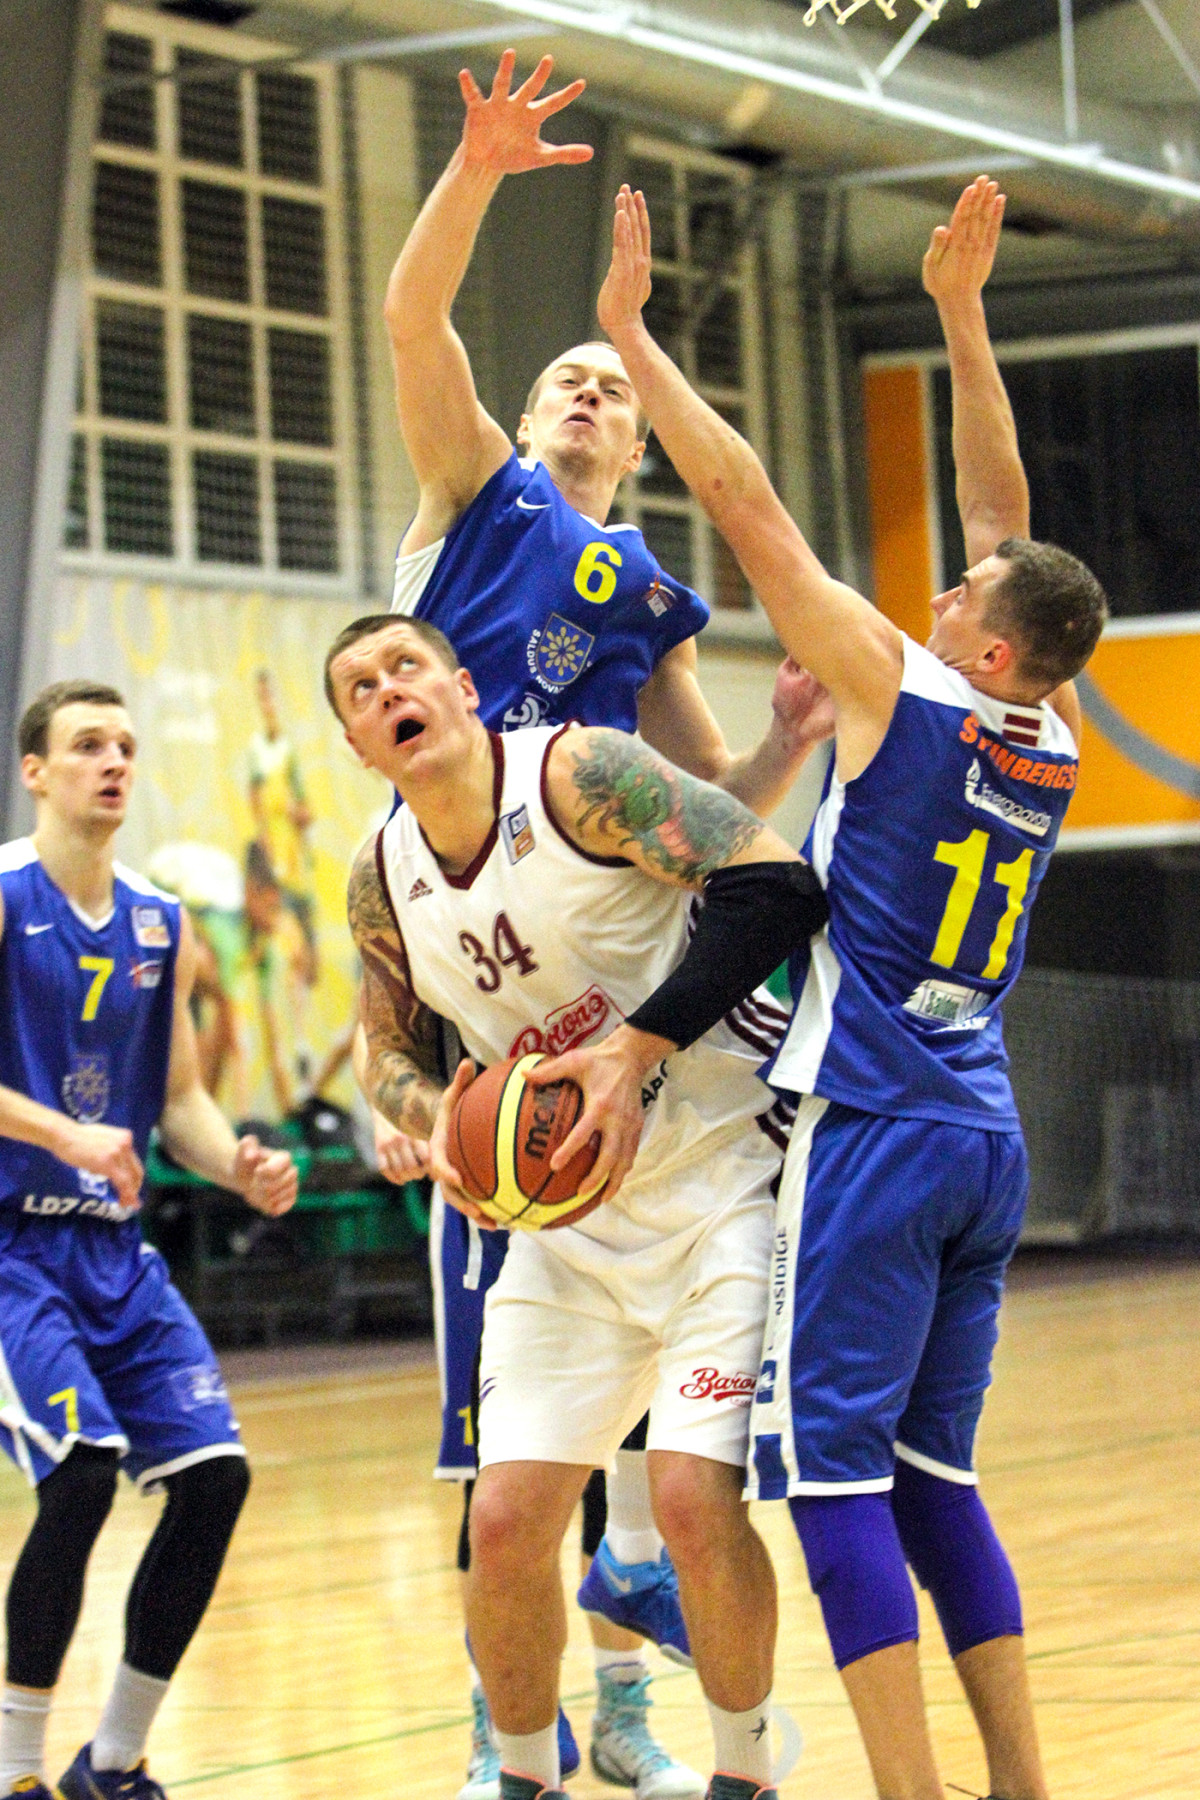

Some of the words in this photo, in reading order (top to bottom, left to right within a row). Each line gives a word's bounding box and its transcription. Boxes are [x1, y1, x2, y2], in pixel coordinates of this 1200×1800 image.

[574, 541, 622, 604] 6
[526, 629, 541, 674] SALDUS
[930, 828, 1036, 981] 11
[457, 910, 540, 994] 34
[79, 956, 115, 1022] 7
[773, 1226, 788, 1316] NSIDIGE
[48, 1387, 78, 1433] 7
